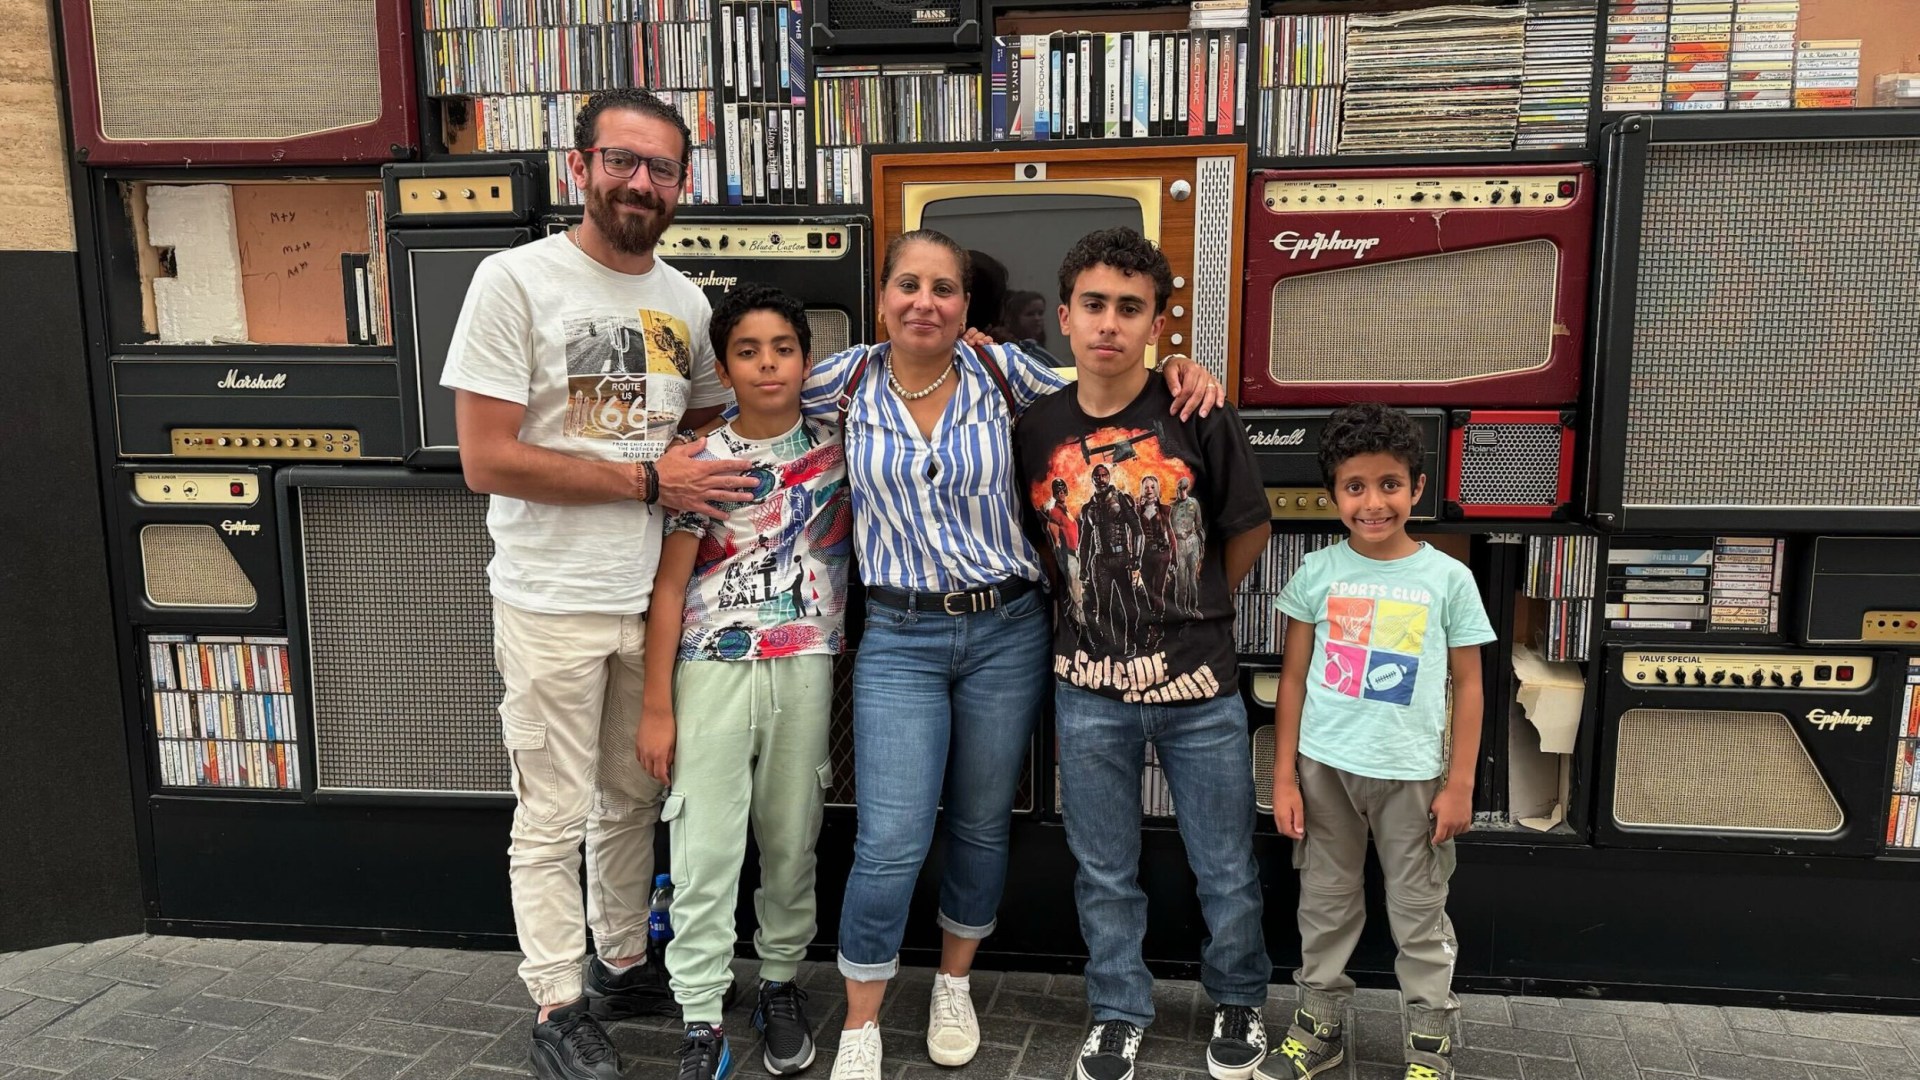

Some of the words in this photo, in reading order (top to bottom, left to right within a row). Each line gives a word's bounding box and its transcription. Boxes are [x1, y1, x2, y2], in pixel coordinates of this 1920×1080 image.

[916, 9, 946, 18] BASS
[1193, 37, 1202, 105] MELECTRONIC
[1222, 34, 1231, 102] MELECTRONIC
[1038, 53, 1046, 119] RECORDOMAX
[728, 119, 737, 183] RECORDOMAX
[749, 240, 773, 251] Blues
[776, 240, 806, 251] Custom
[1269, 229, 1380, 259] Epiphone
[217, 368, 287, 390] Marshall
[611, 382, 641, 391] ROUTE
[621, 391, 633, 400] US
[600, 395, 646, 429] 66
[1245, 423, 1306, 446] arshall
[220, 519, 261, 536] Epiphone
[1330, 581, 1388, 598] SPORTS
[1391, 586, 1431, 603] CLUB
[1054, 654, 1072, 678] THE
[1070, 649, 1170, 692] SUICIDE
[1639, 655, 1666, 663] VALVE
[1667, 655, 1702, 664] SPECIAL
[1805, 708, 1873, 732] Epiphone
